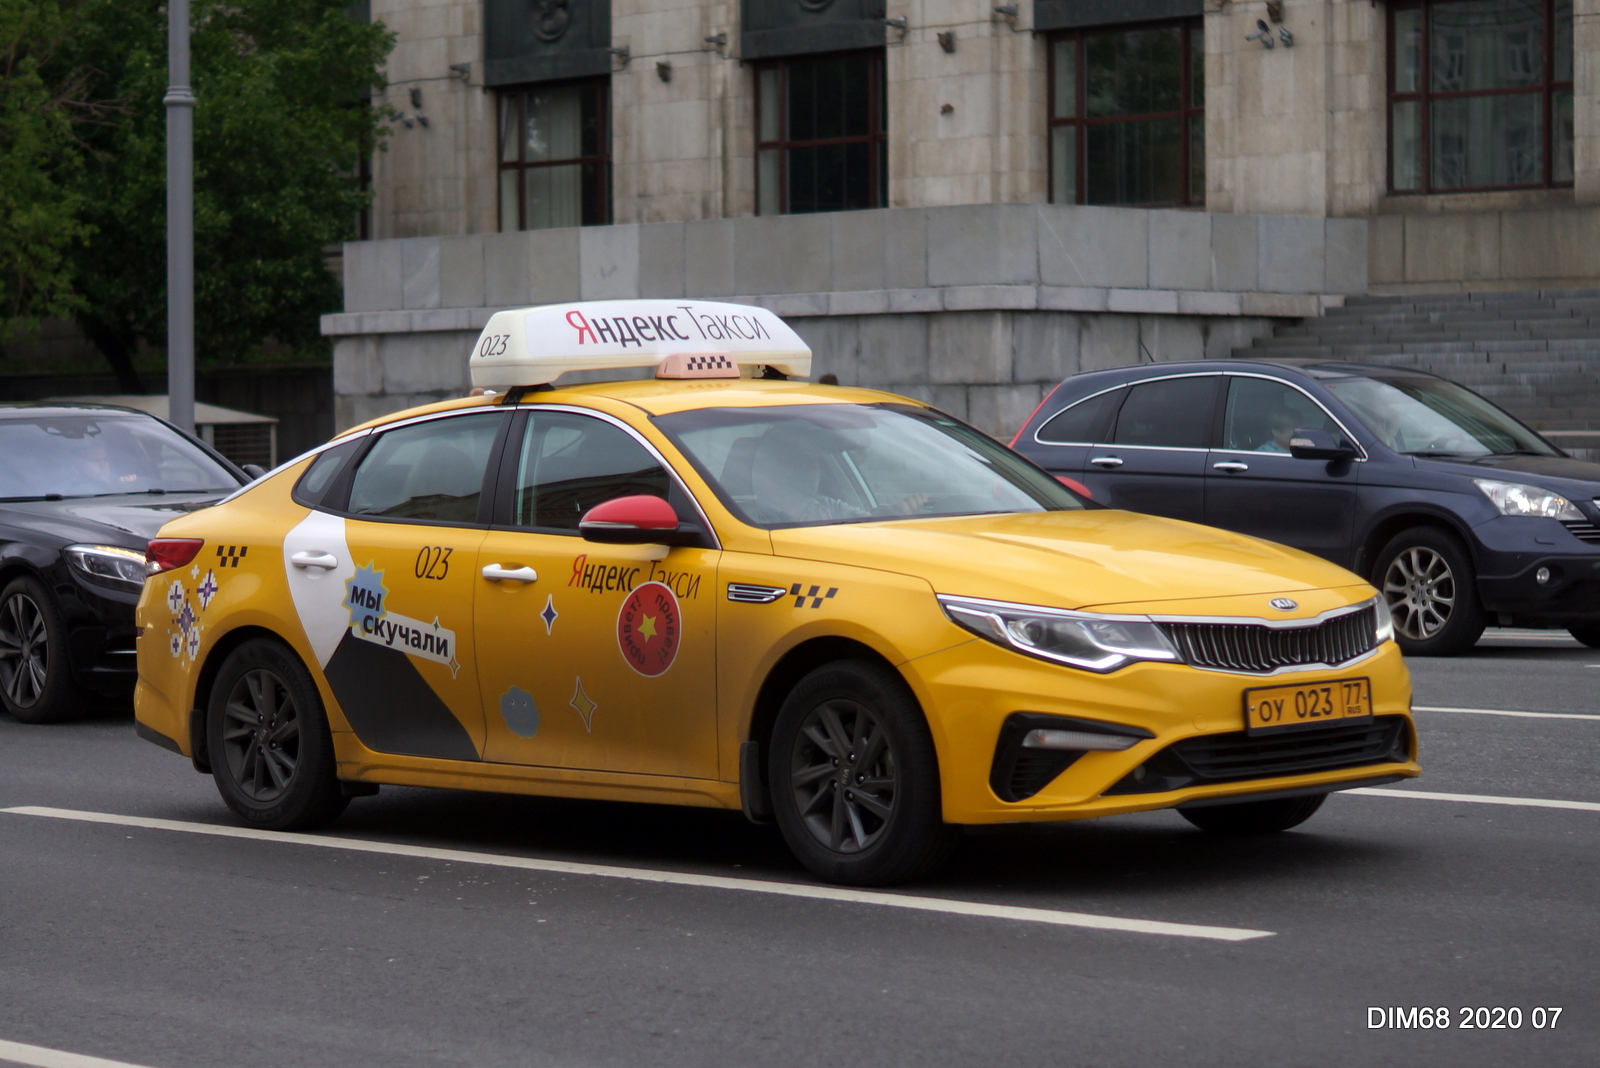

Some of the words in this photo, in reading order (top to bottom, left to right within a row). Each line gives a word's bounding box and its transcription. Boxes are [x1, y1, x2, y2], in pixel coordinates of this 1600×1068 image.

[565, 310, 689, 347] Яндекс
[676, 306, 770, 341] Такси
[480, 334, 511, 357] 023
[415, 546, 453, 580] 023
[363, 615, 449, 658] скучали
[1295, 688, 1333, 719] 023
[1343, 683, 1362, 705] 77
[1347, 706, 1362, 714] RUS
